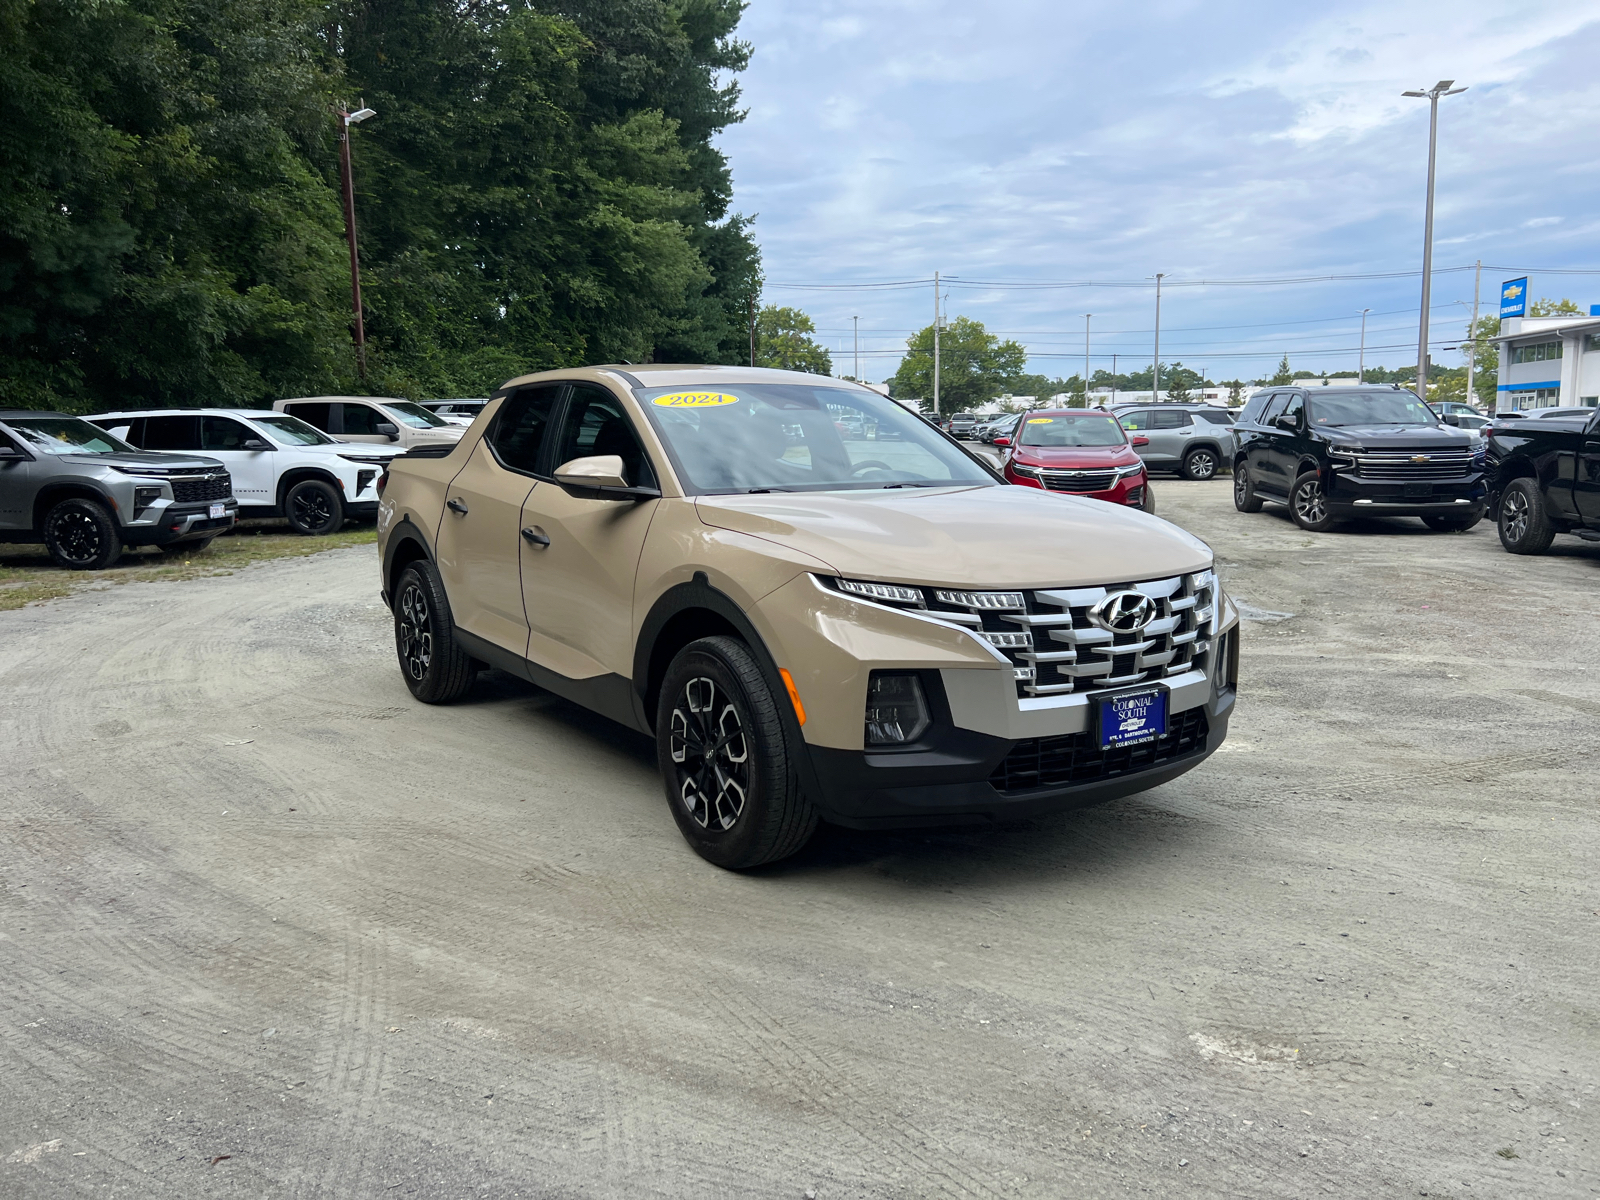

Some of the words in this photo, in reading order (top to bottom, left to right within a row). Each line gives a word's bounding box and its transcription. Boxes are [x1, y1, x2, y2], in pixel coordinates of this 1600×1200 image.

[1501, 304, 1523, 314] CHEVROLET
[669, 394, 725, 406] 2024
[1112, 697, 1153, 712] COLONIAL
[1118, 707, 1147, 720] SOUTH
[1116, 739, 1139, 748] COLONIAL
